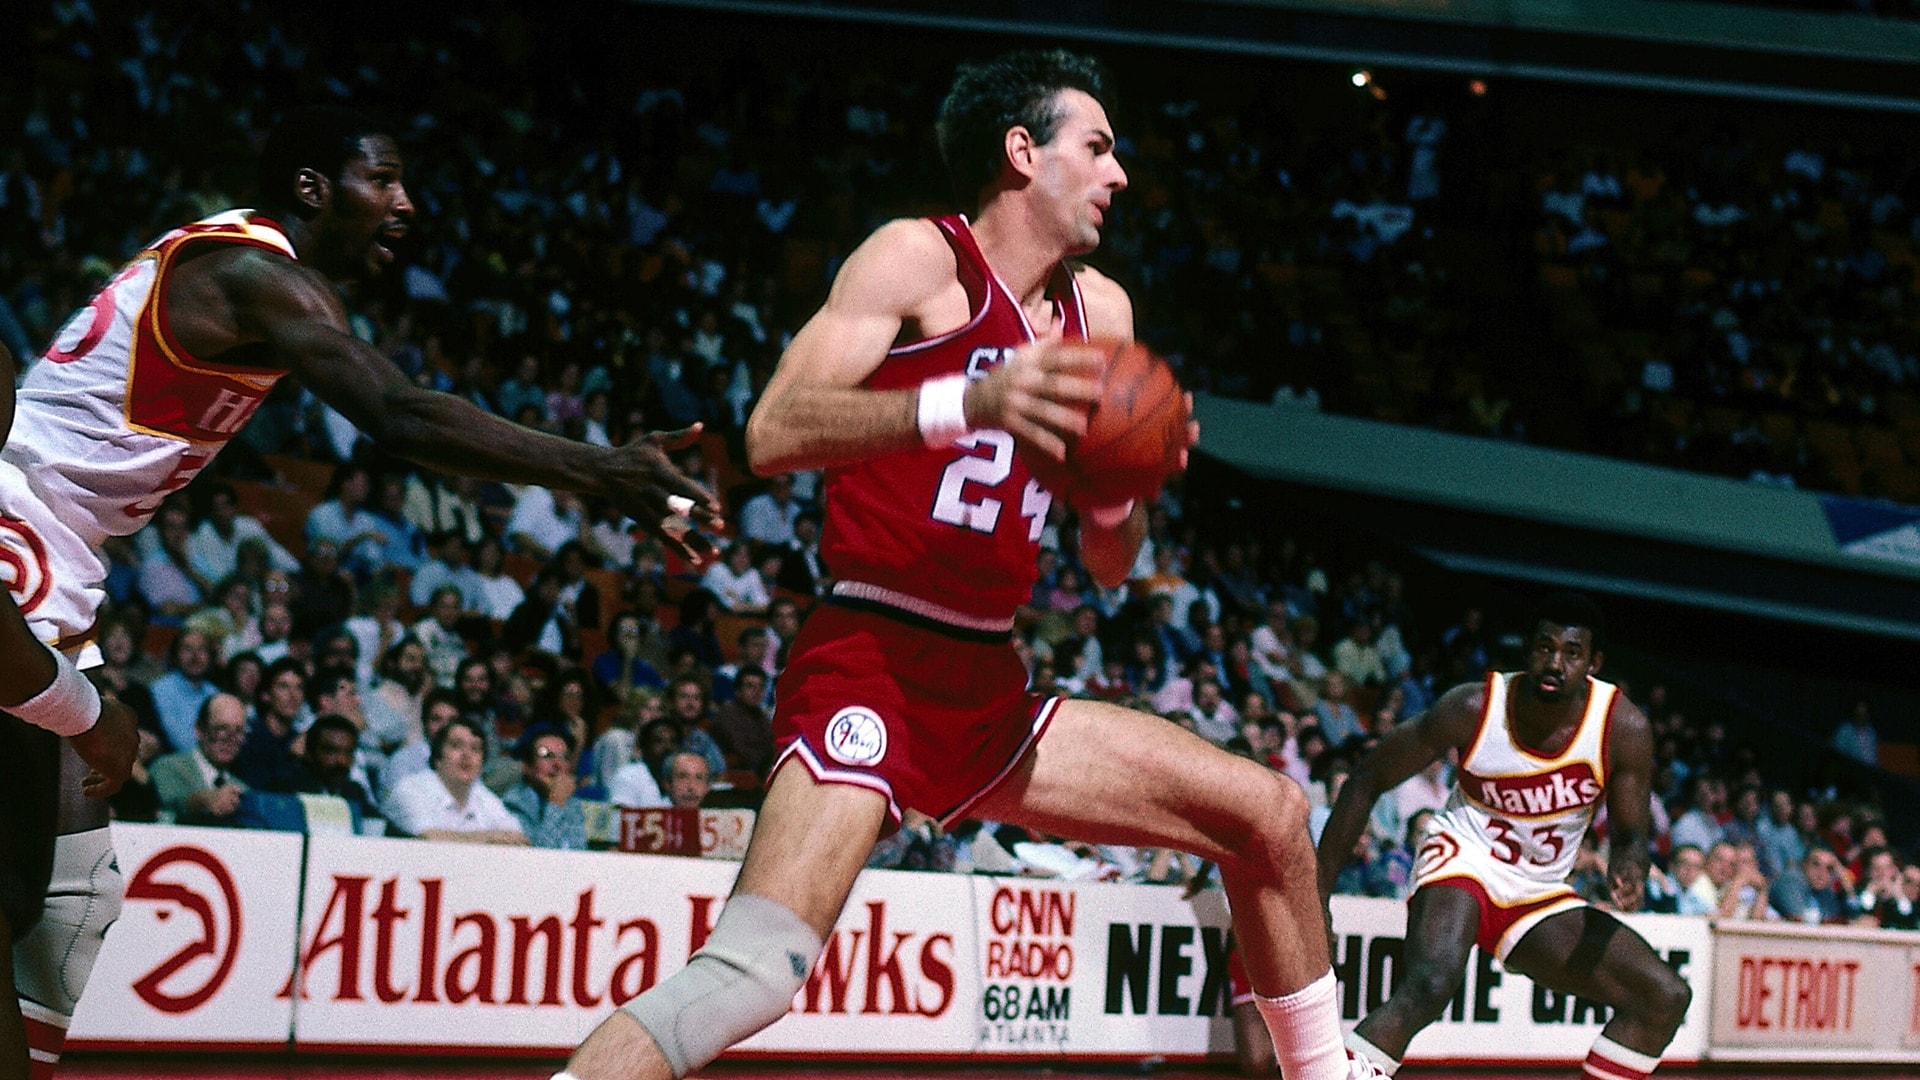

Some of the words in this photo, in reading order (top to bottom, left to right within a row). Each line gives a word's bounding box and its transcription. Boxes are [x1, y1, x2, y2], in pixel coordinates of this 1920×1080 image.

[931, 428, 1053, 543] 24
[1486, 817, 1565, 867] 33
[991, 887, 1076, 936] CNN
[276, 874, 659, 1008] Atlanta
[687, 893, 955, 1018] wks
[986, 941, 1073, 981] RADIO
[1104, 923, 1235, 1017] NEX
[1335, 934, 1502, 1023] HOE
[1737, 956, 1860, 1031] DETROIT
[983, 985, 1021, 1021] 68
[1025, 986, 1070, 1020] AM
[980, 1025, 1069, 1044] ATLANTA
